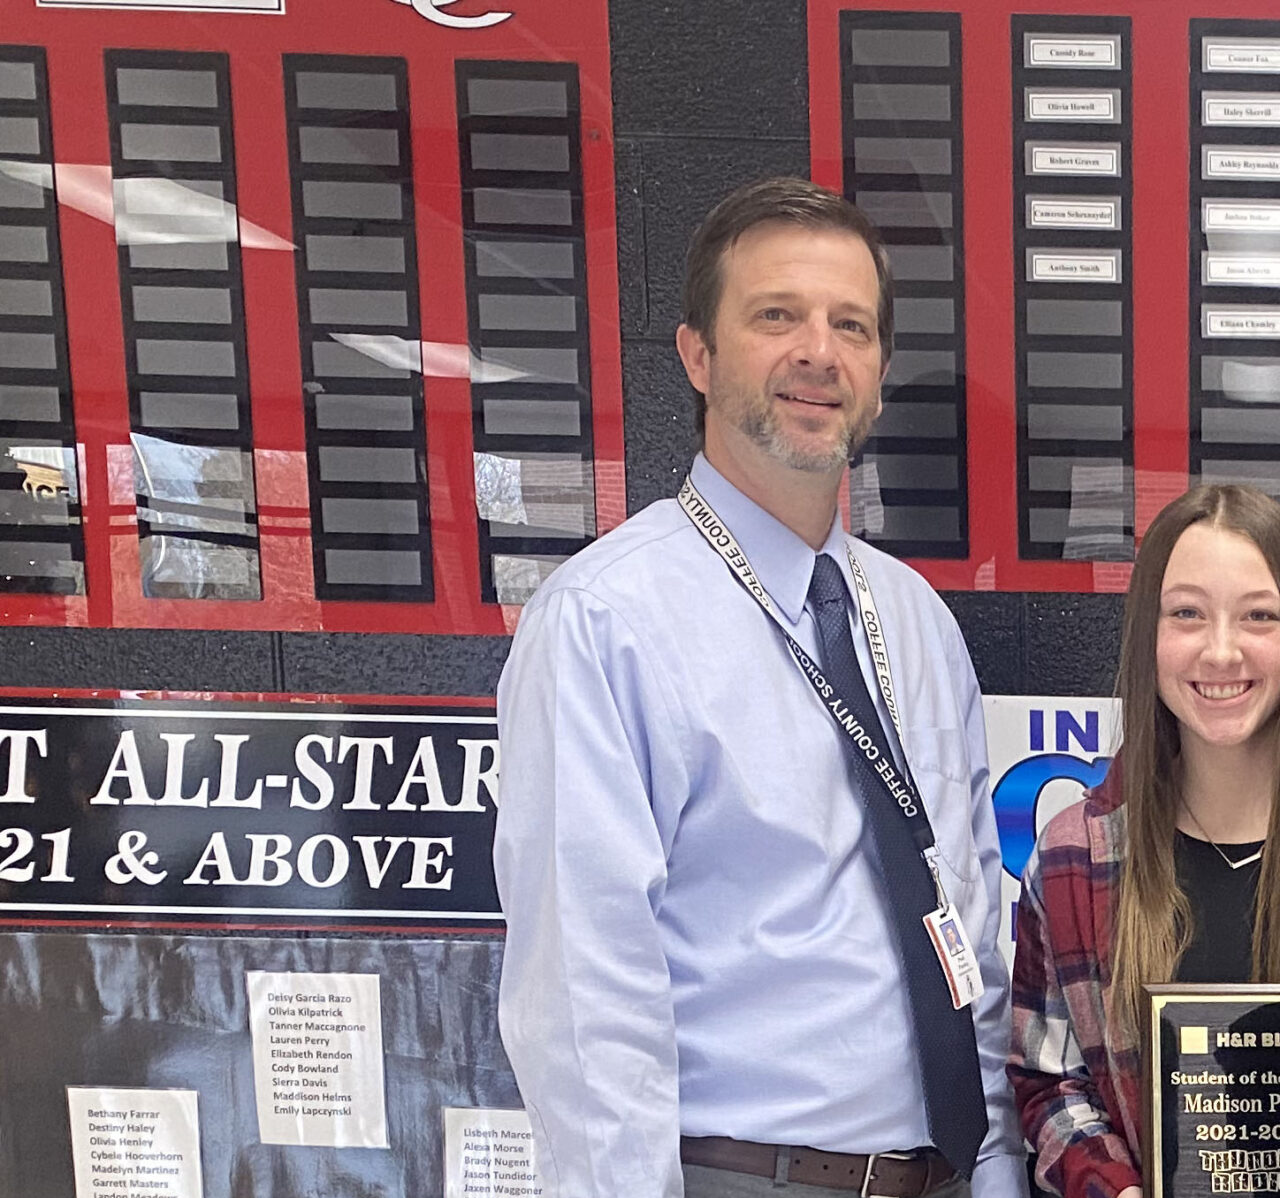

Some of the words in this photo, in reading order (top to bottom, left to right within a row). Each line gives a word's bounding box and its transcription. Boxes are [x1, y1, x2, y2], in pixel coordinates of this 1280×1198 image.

[828, 698, 880, 761] COUNTY
[1029, 709, 1099, 752] IN
[874, 757, 918, 818] COFFEE
[0, 828, 75, 884] 21
[104, 829, 168, 886] &
[183, 832, 454, 891] ABOVE
[295, 994, 326, 1002] Garcia
[328, 994, 352, 1003] Razo
[268, 1008, 295, 1016] Olivia
[298, 1008, 343, 1018] Kilpatrick
[270, 1022, 302, 1030] Tanner
[270, 1036, 302, 1044] Lauren
[305, 1036, 330, 1046] Perry
[1216, 1032, 1257, 1047] H&R
[271, 1050, 313, 1058] Elizabeth
[316, 1051, 352, 1059] Rendon
[272, 1064, 295, 1074] Cody
[298, 1064, 339, 1073] Bowland
[272, 1078, 299, 1086] Sierra
[302, 1078, 327, 1087] Davis
[1170, 1071, 1235, 1085] Student
[1239, 1071, 1256, 1085] of
[1184, 1093, 1263, 1113] Madison
[88, 1109, 127, 1120] Bethany
[130, 1110, 160, 1119] Farrar
[274, 1106, 299, 1116] Emily
[89, 1123, 124, 1134] Destiny
[127, 1124, 155, 1134] Haley
[90, 1137, 116, 1146] Olivia
[120, 1138, 153, 1148] Henley
[493, 1144, 524, 1153] Morse
[464, 1156, 491, 1166] Brady
[494, 1158, 530, 1167] Nugent
[92, 1165, 133, 1175] Madelyn
[136, 1166, 179, 1174] Martinez
[464, 1170, 490, 1179] Jason
[493, 1172, 537, 1181] Tundidor
[92, 1179, 127, 1188] Garrett
[129, 1180, 168, 1188] Masters
[493, 1185, 542, 1195] Waggoner
